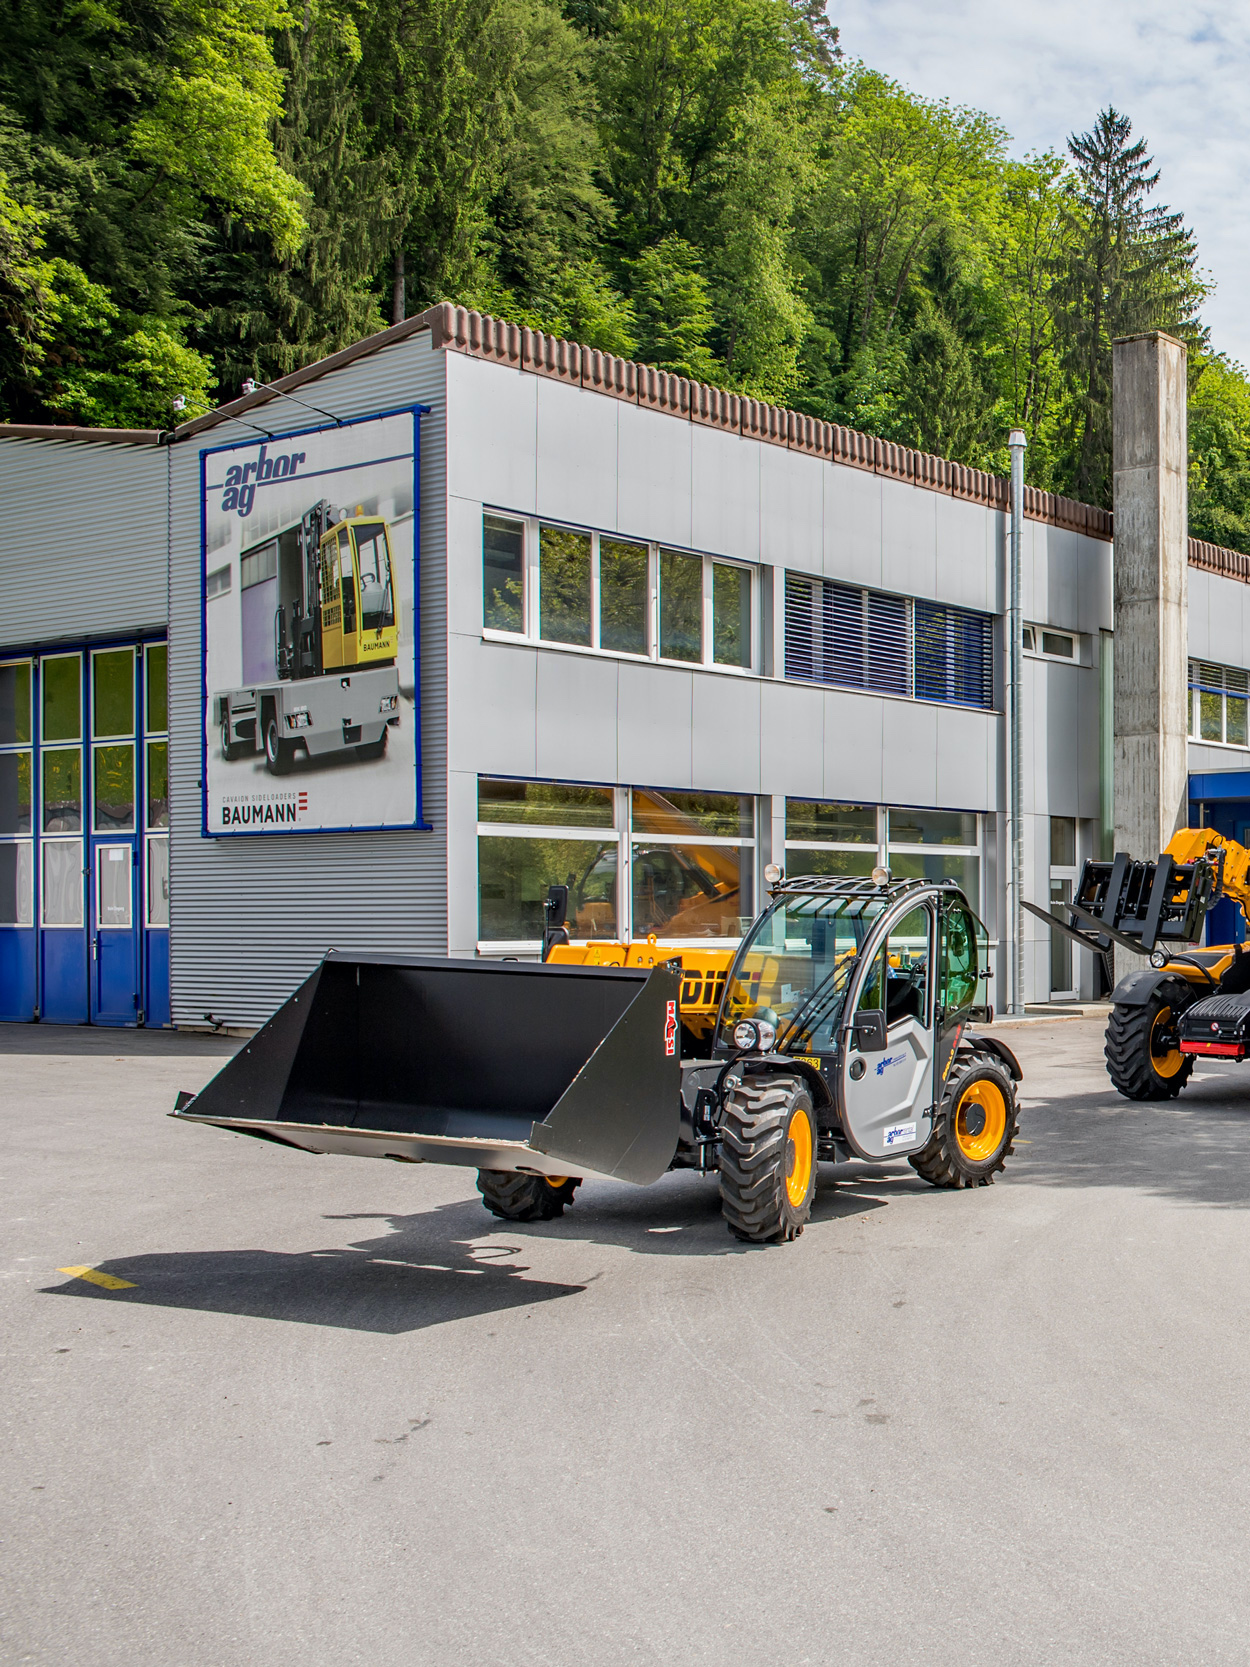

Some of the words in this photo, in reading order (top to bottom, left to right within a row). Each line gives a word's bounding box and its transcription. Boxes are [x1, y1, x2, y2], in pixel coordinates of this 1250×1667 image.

[225, 445, 306, 487] arbor
[221, 483, 256, 517] ag
[363, 641, 390, 651] BAUMANN
[222, 795, 249, 803] CAVAION
[251, 792, 296, 802] SIDELOADERS
[222, 803, 297, 825] BAUMANN
[666, 1001, 676, 1055] MAGSI
